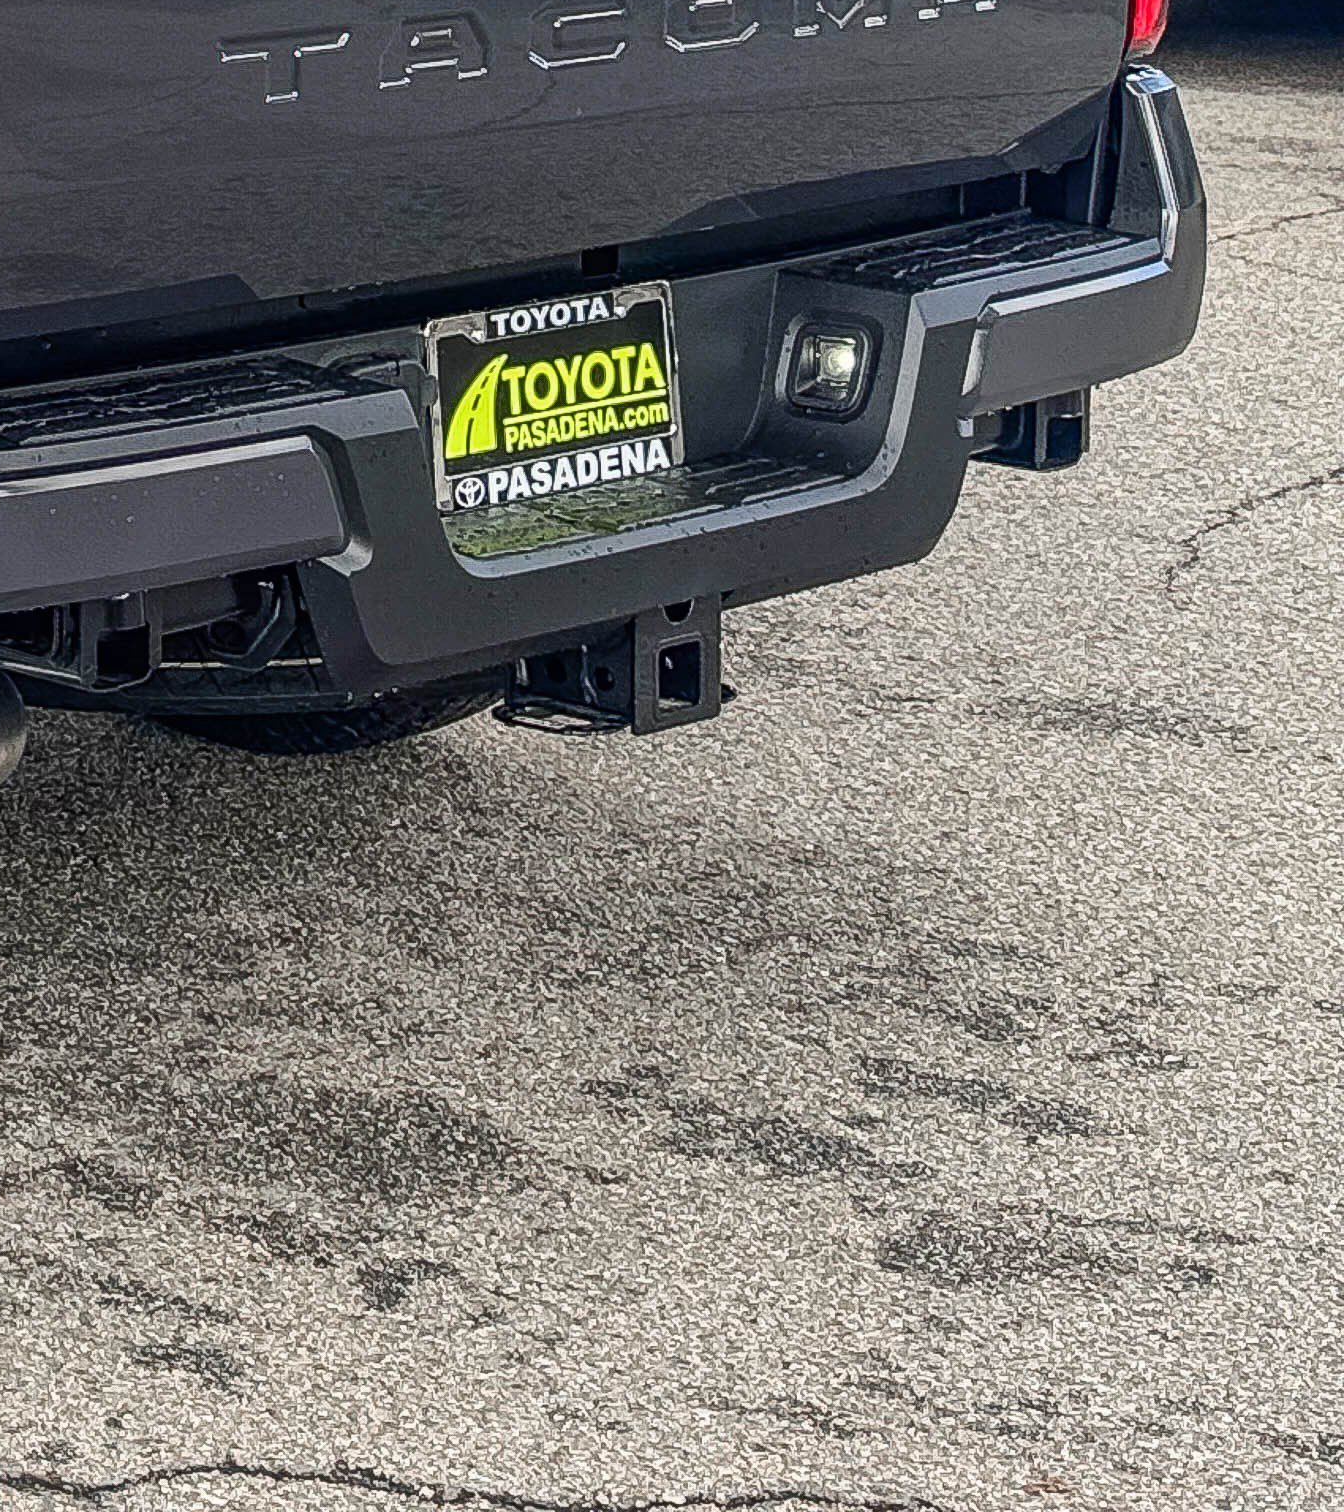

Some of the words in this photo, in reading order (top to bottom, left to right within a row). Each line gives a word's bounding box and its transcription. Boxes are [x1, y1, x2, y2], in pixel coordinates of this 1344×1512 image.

[489, 296, 610, 337] TOYOTA
[500, 342, 666, 415] TOYOTA
[504, 401, 670, 454] PASADENA.com
[487, 438, 671, 505] PASADENA
